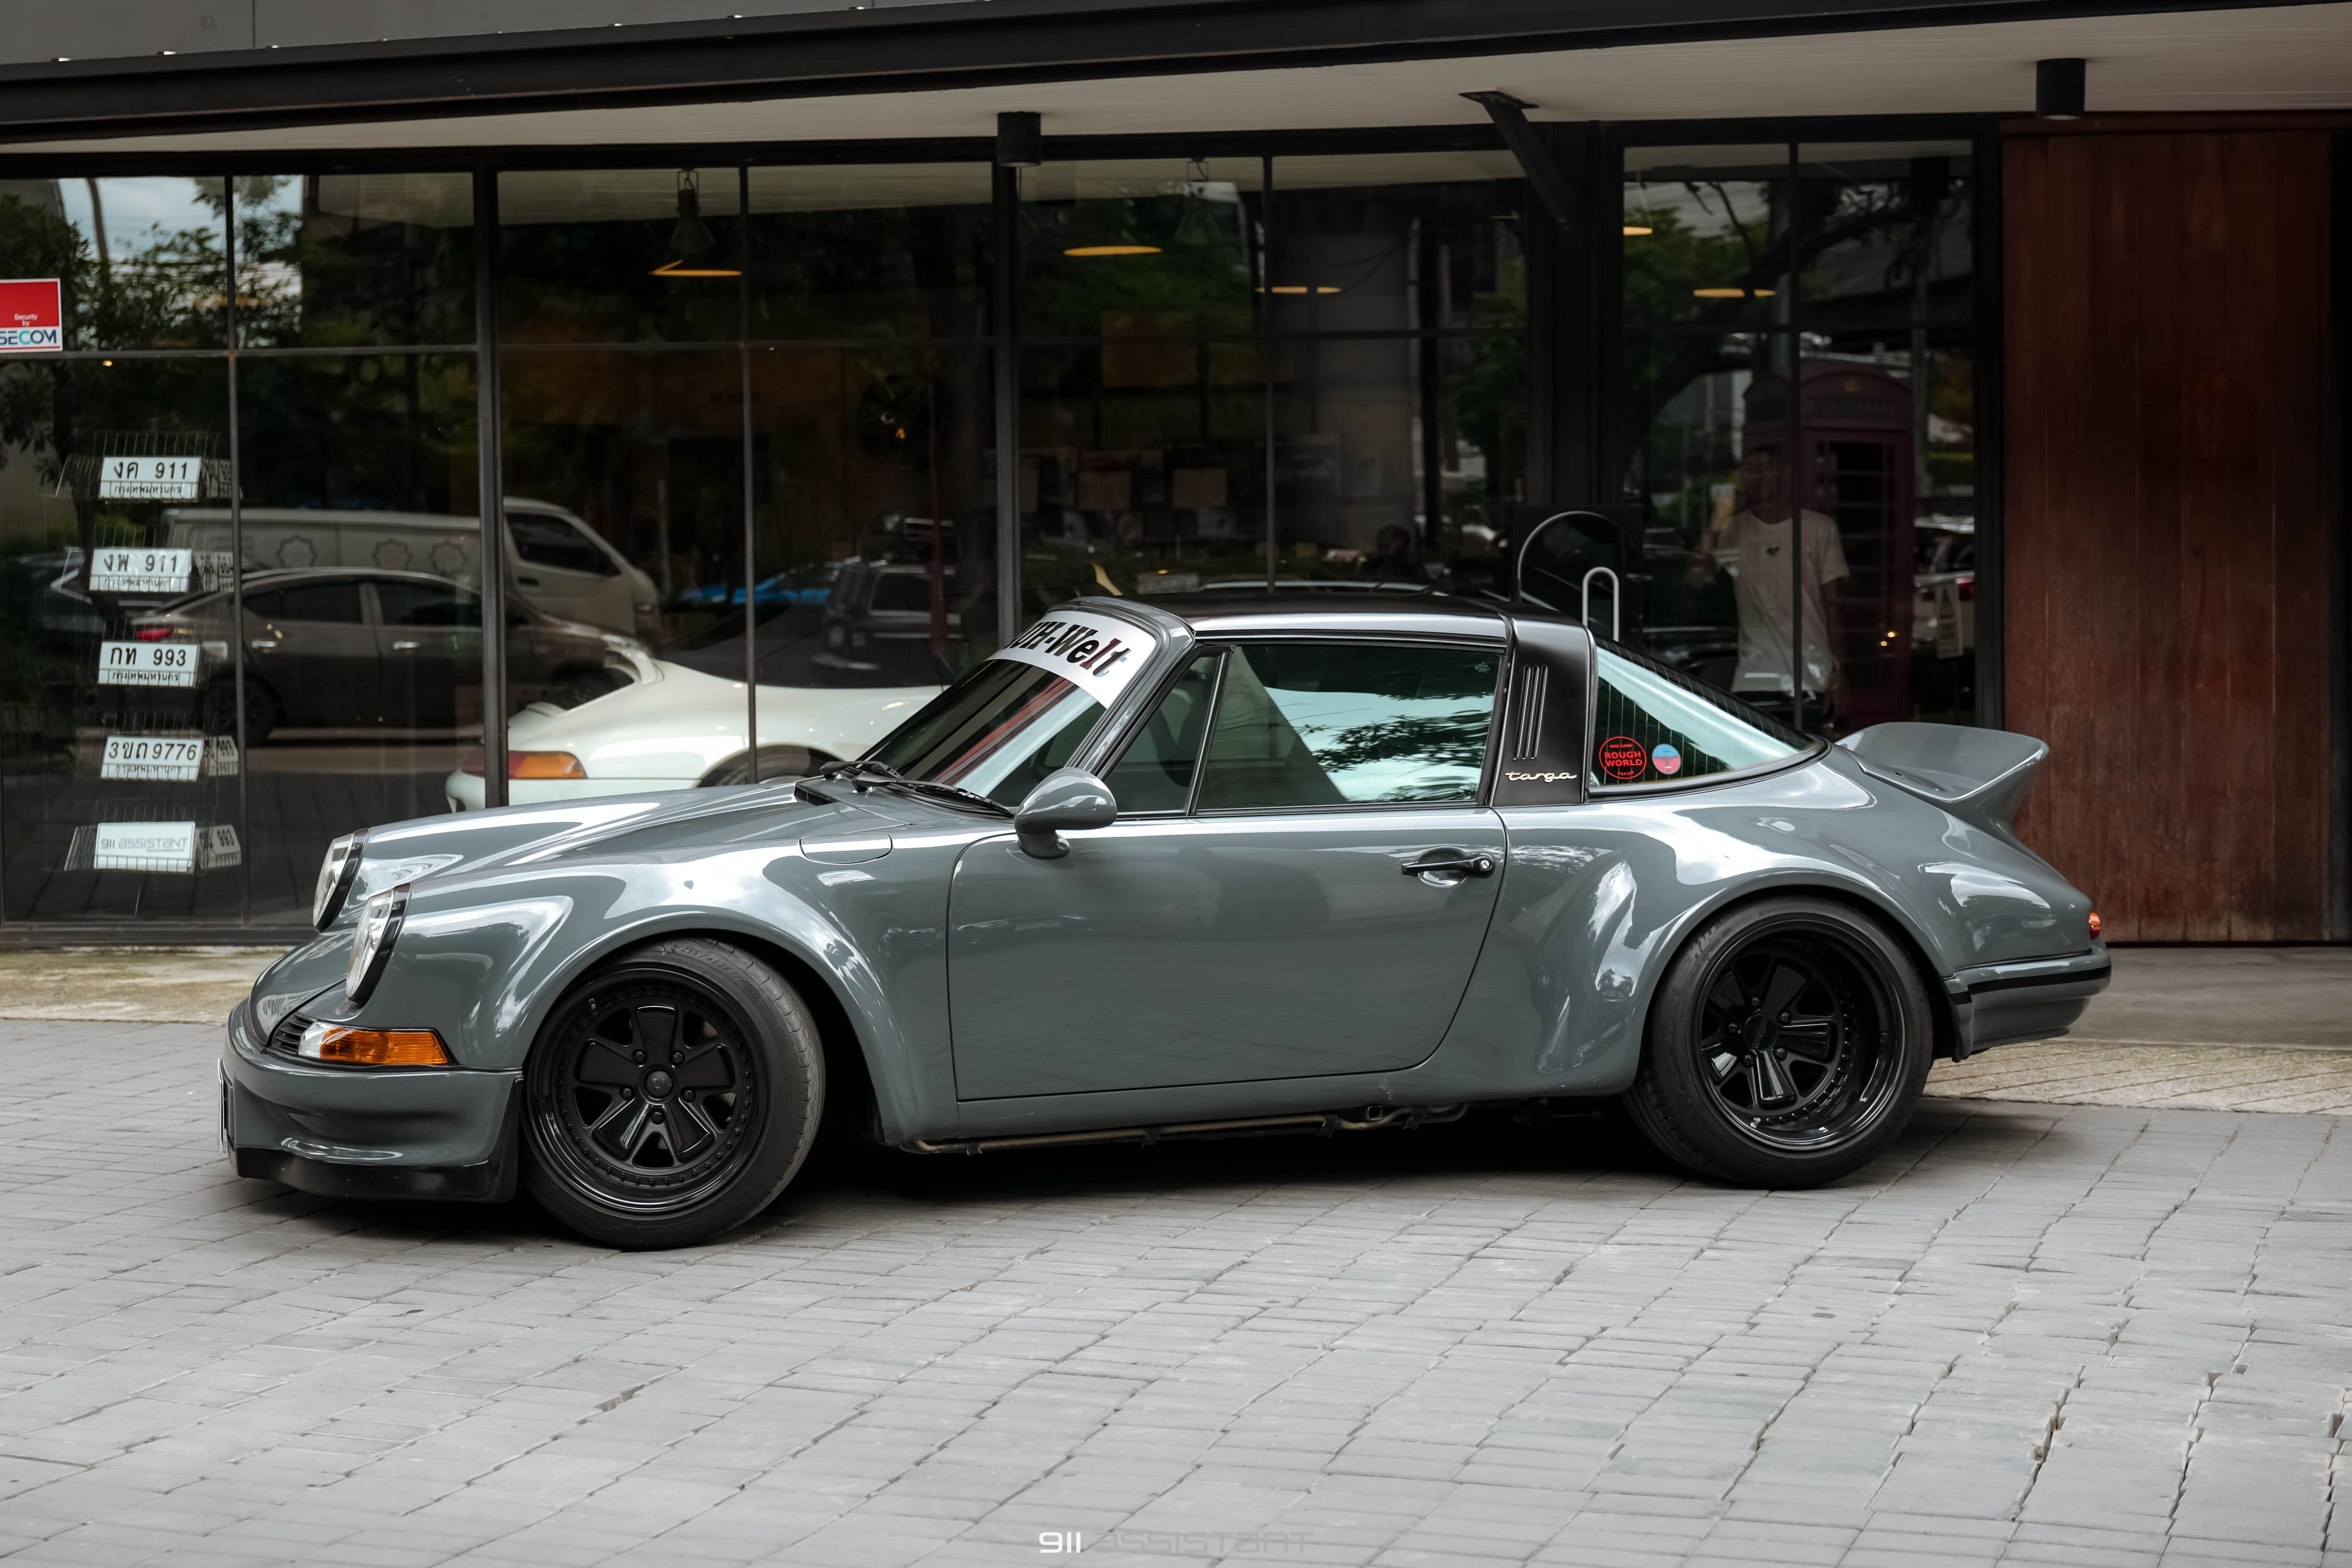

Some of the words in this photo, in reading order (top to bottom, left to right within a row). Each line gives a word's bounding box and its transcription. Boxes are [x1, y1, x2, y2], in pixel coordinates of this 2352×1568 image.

[0, 330, 57, 345] SECOM
[155, 462, 187, 480] 911
[145, 554, 177, 572] 911
[153, 649, 186, 666] 993
[152, 743, 198, 761] 9776
[1604, 751, 1641, 759] ROUGH
[1605, 759, 1643, 767] WORLD
[1505, 771, 1577, 783] targa
[101, 839, 115, 850] 911
